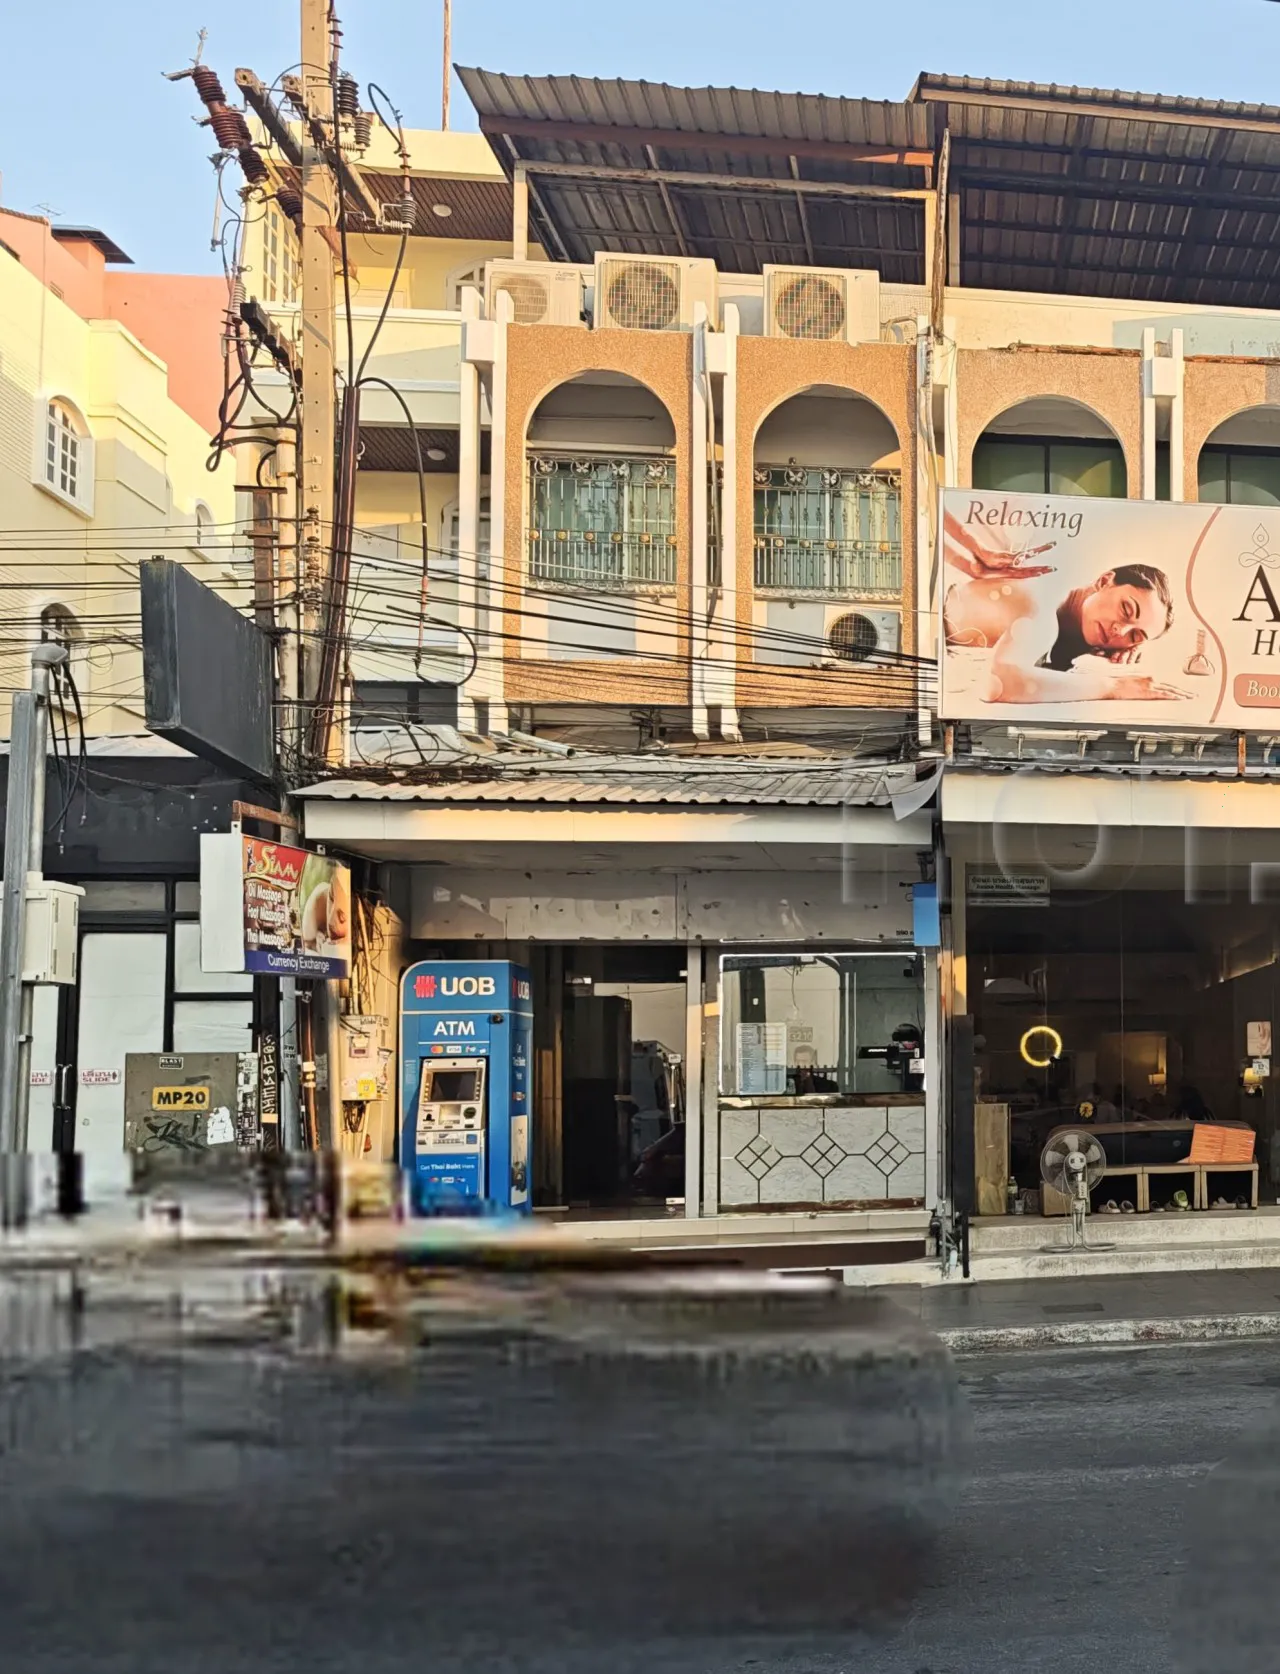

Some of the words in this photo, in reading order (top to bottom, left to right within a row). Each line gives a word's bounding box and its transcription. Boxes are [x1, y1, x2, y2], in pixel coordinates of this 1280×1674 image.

[965, 500, 1083, 538] Relaxing
[257, 884, 282, 905] Massage
[248, 904, 259, 919] Foot
[260, 905, 285, 927] Massage
[247, 928, 258, 943] Thai
[259, 930, 285, 950] Massage
[267, 954, 299, 970] Currency
[300, 957, 330, 973] Exchange
[440, 976, 496, 996] UOB
[518, 980, 530, 1000] UOB
[433, 1020, 476, 1036] ATM
[157, 1091, 206, 1105] MP20
